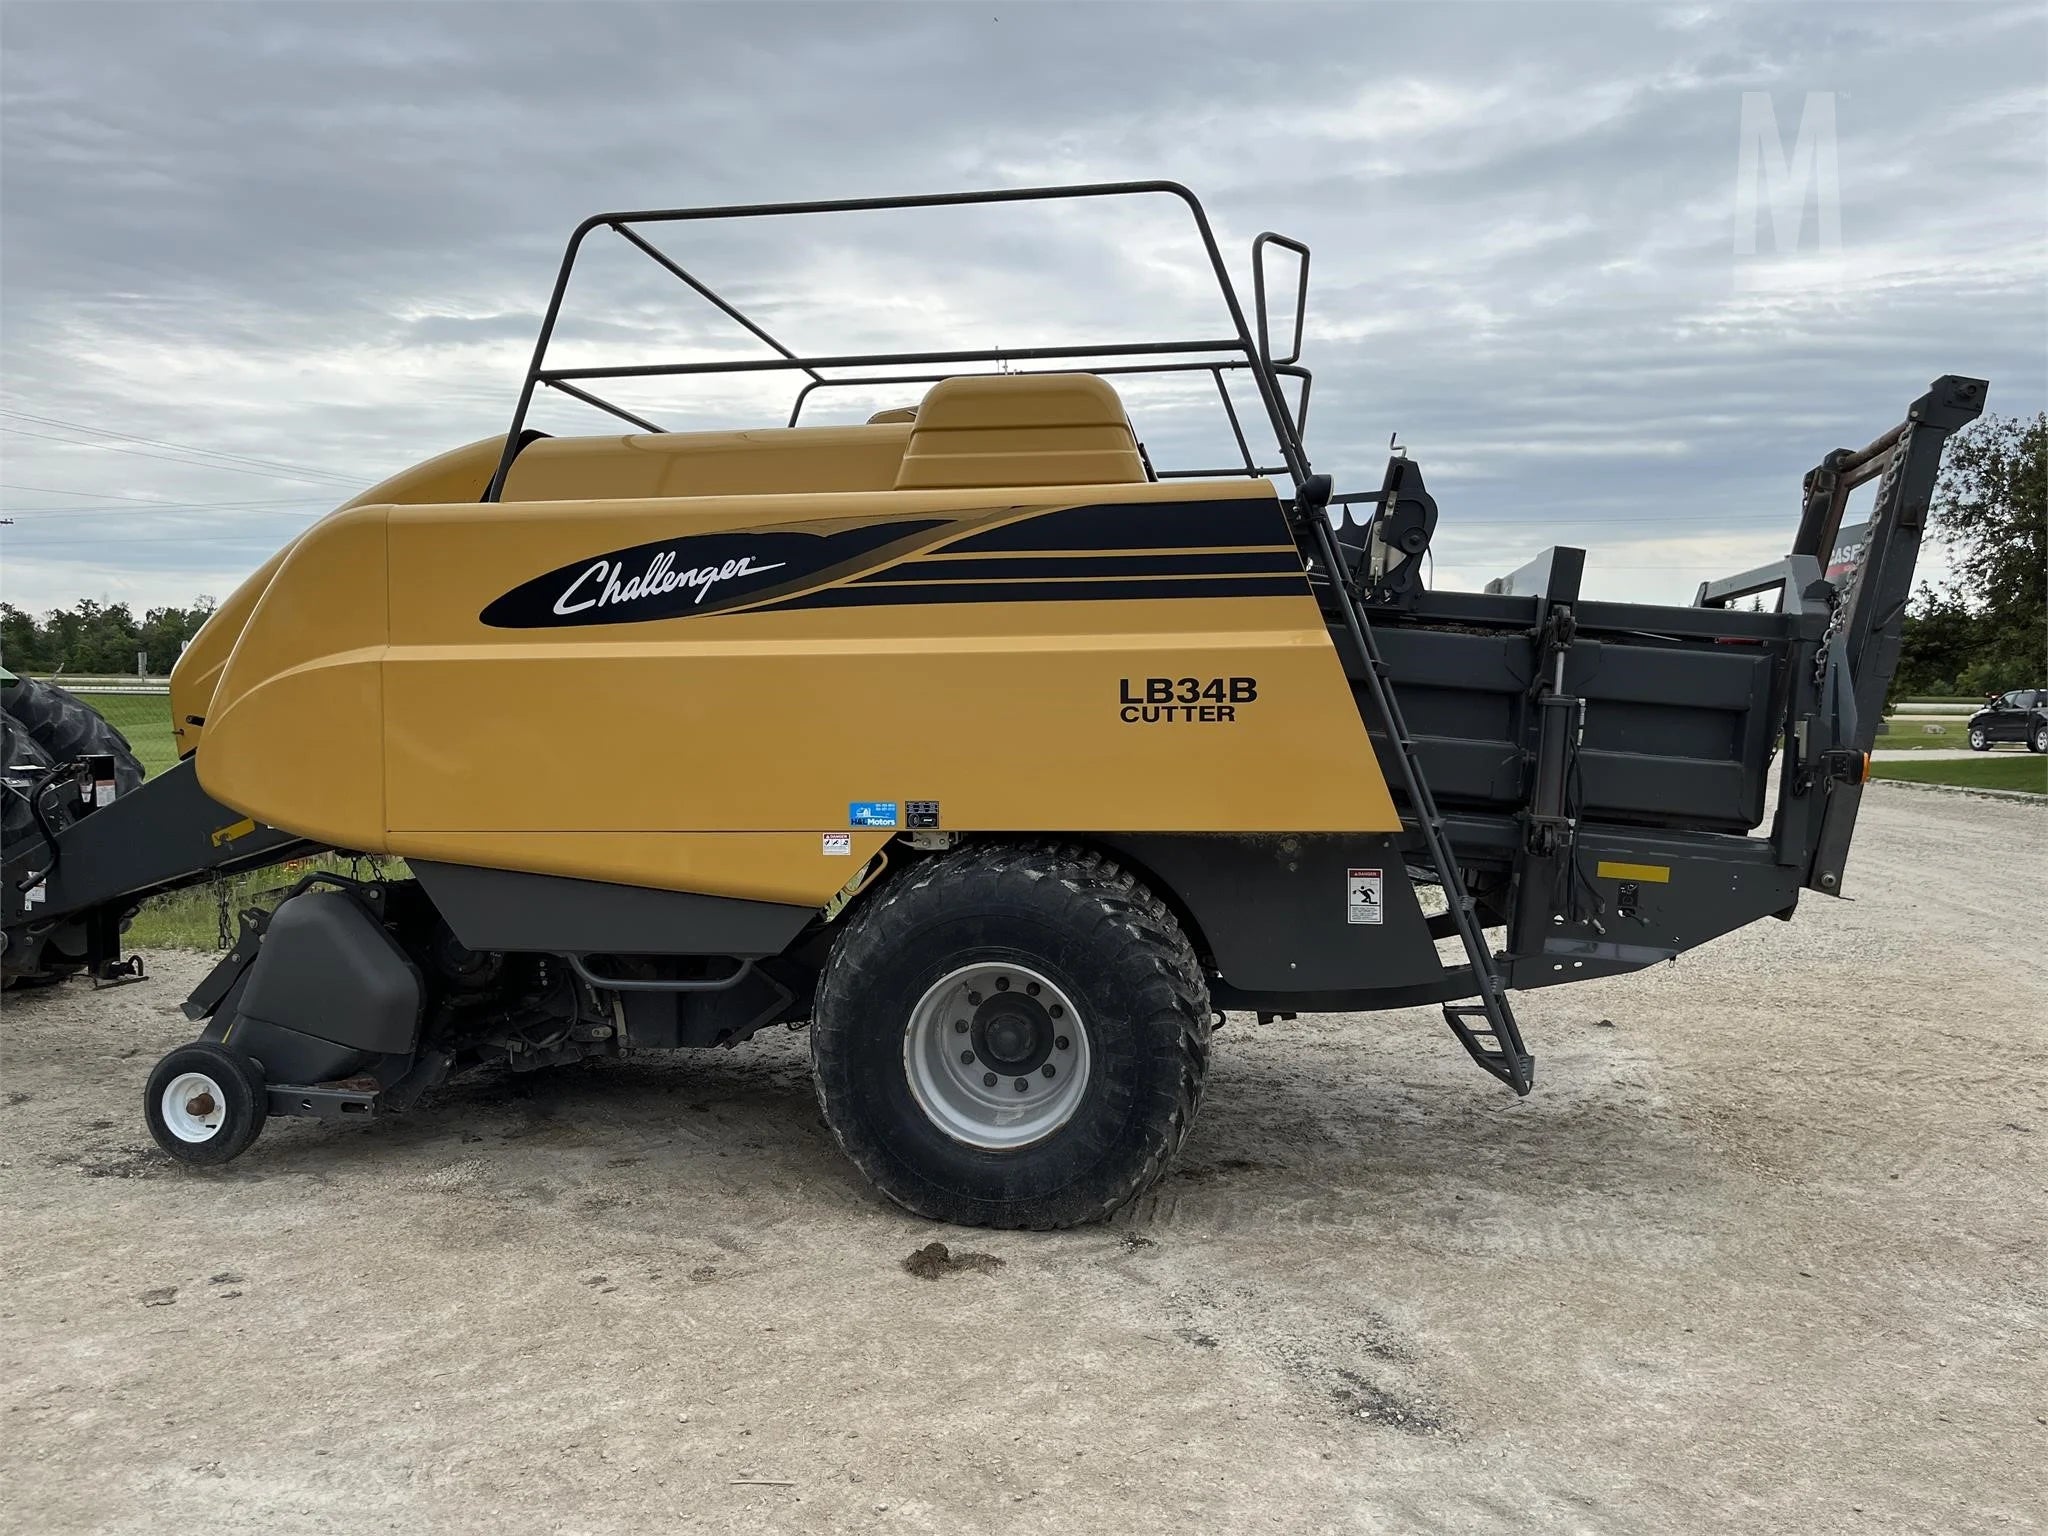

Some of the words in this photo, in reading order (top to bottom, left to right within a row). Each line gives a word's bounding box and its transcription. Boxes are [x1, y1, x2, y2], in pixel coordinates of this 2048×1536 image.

[553, 551, 786, 615] Challenger
[1120, 677, 1258, 704] LB34B
[1120, 706, 1236, 723] CUTTER
